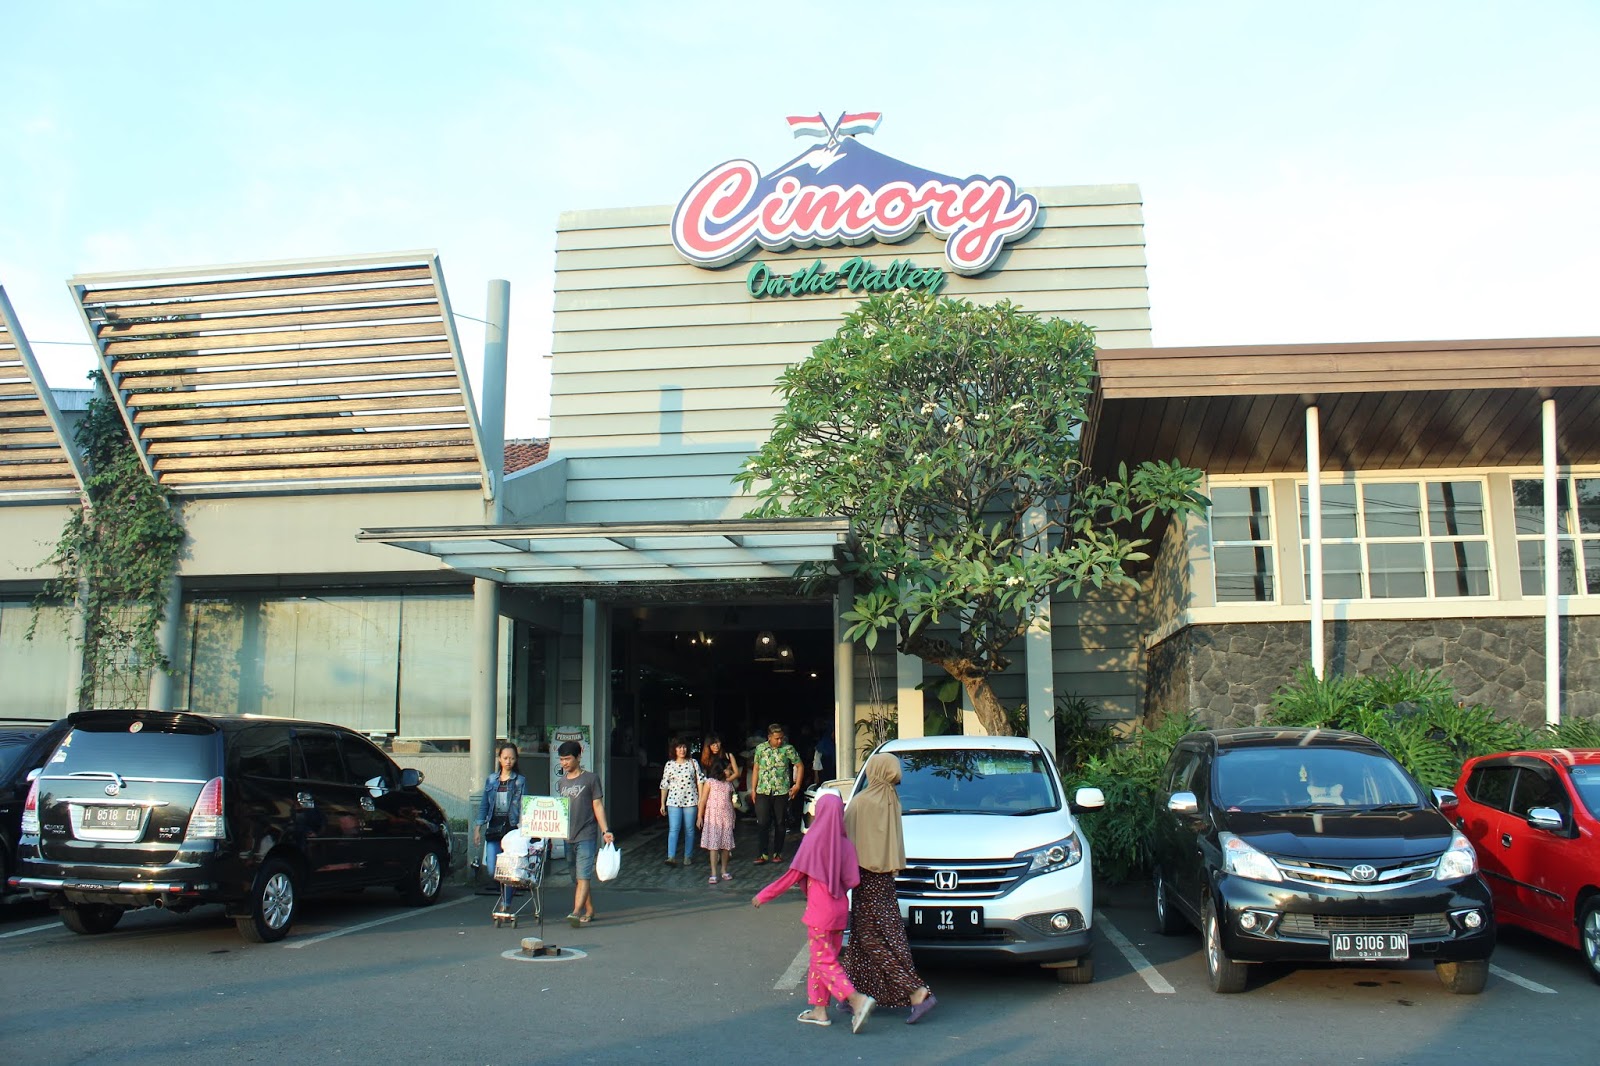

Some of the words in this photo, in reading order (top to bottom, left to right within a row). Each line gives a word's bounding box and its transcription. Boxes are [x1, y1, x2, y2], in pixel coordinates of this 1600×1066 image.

[681, 165, 1029, 263] Cimory
[746, 261, 787, 298] On
[789, 258, 836, 294] the
[838, 256, 945, 296] Valley
[85, 808, 93, 821] H
[97, 809, 119, 821] 8518
[125, 809, 138, 821] EH
[534, 809, 558, 820] PINTU
[531, 821, 561, 832] MASUK
[915, 910, 923, 925] H
[940, 910, 954, 925] 12
[1335, 935, 1351, 951] AD
[1355, 935, 1385, 950] 9106
[1390, 935, 1406, 950] DN
